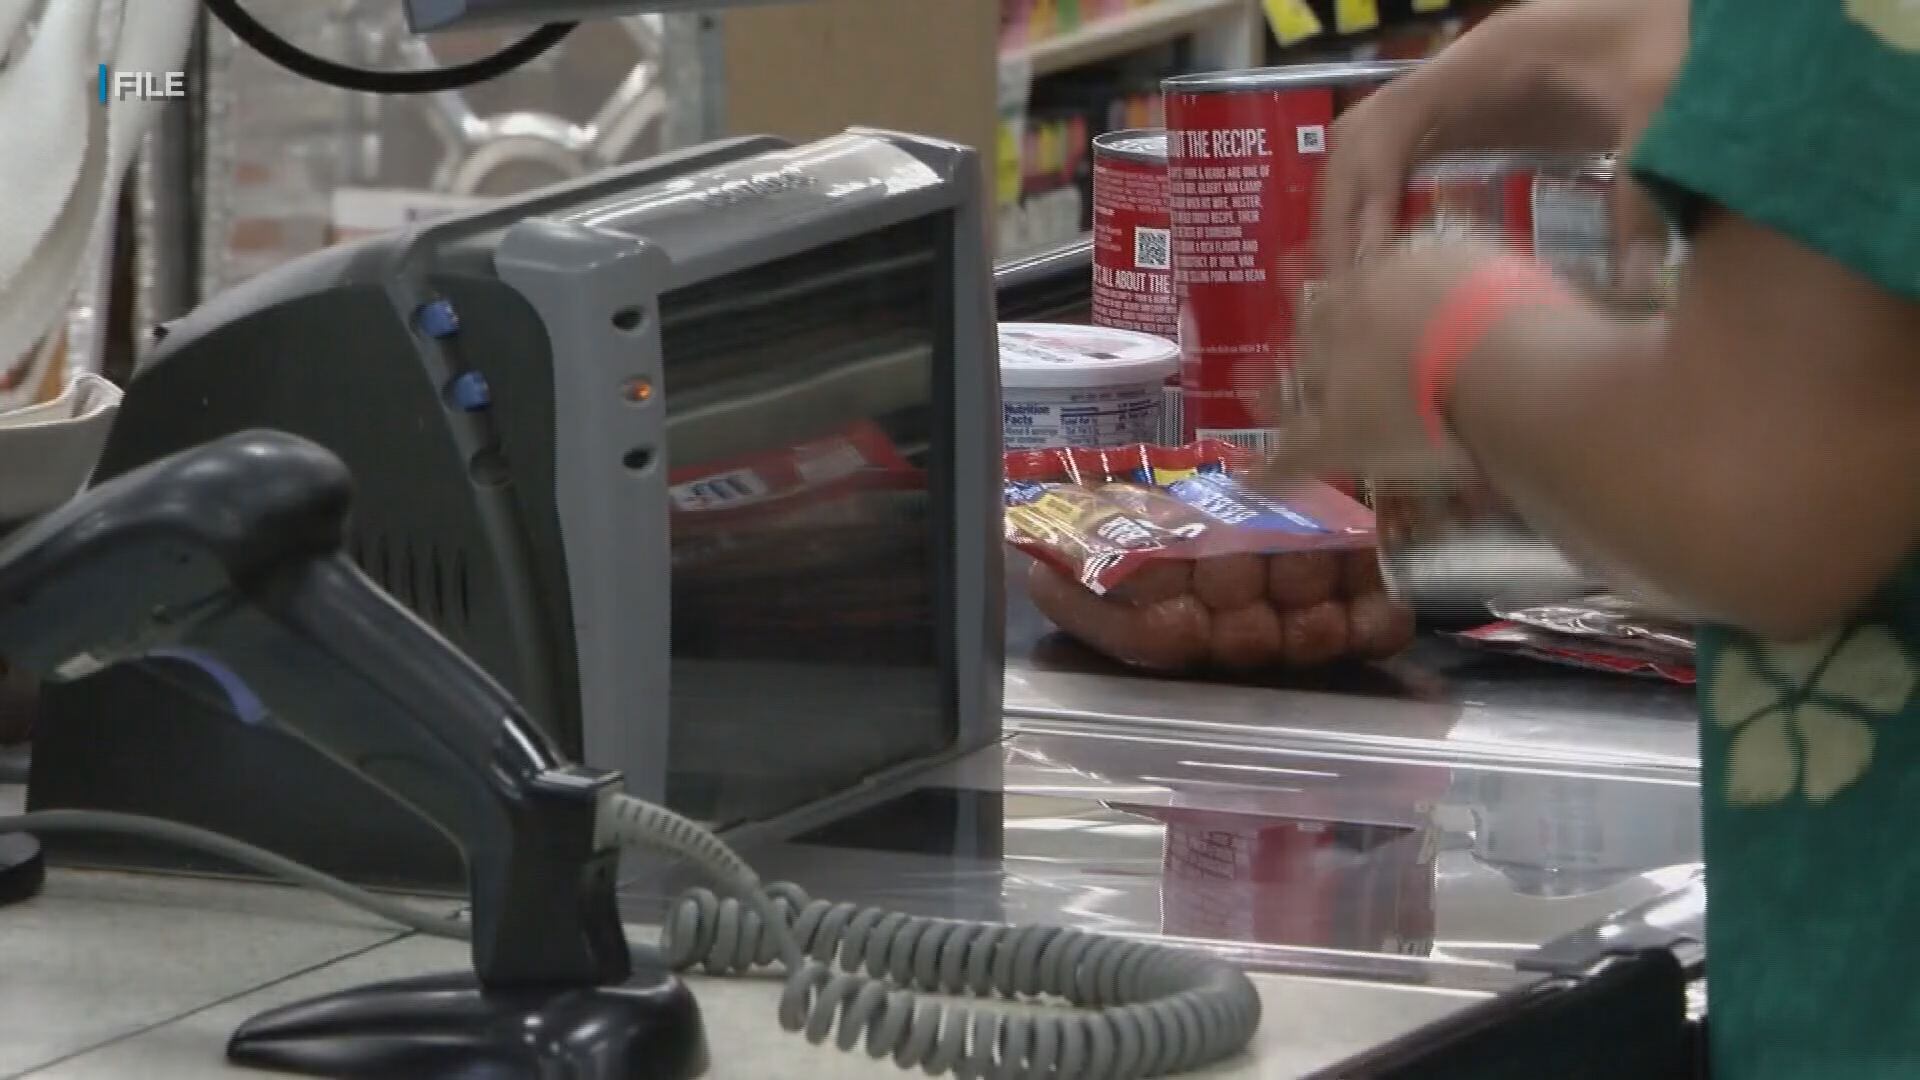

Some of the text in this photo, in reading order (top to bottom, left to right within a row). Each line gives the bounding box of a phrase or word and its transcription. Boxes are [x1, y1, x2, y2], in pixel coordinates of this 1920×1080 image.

[1188, 129, 1211, 158] THE
[1213, 128, 1274, 158] RECIPE.
[1227, 166, 1242, 180] ARE
[1260, 165, 1271, 178] OF
[1240, 180, 1263, 194] CAMP
[1115, 269, 1147, 293] ABOUT
[1148, 273, 1171, 294] THE
[1005, 403, 1050, 415] Nutrition
[1005, 415, 1033, 426] Facts
